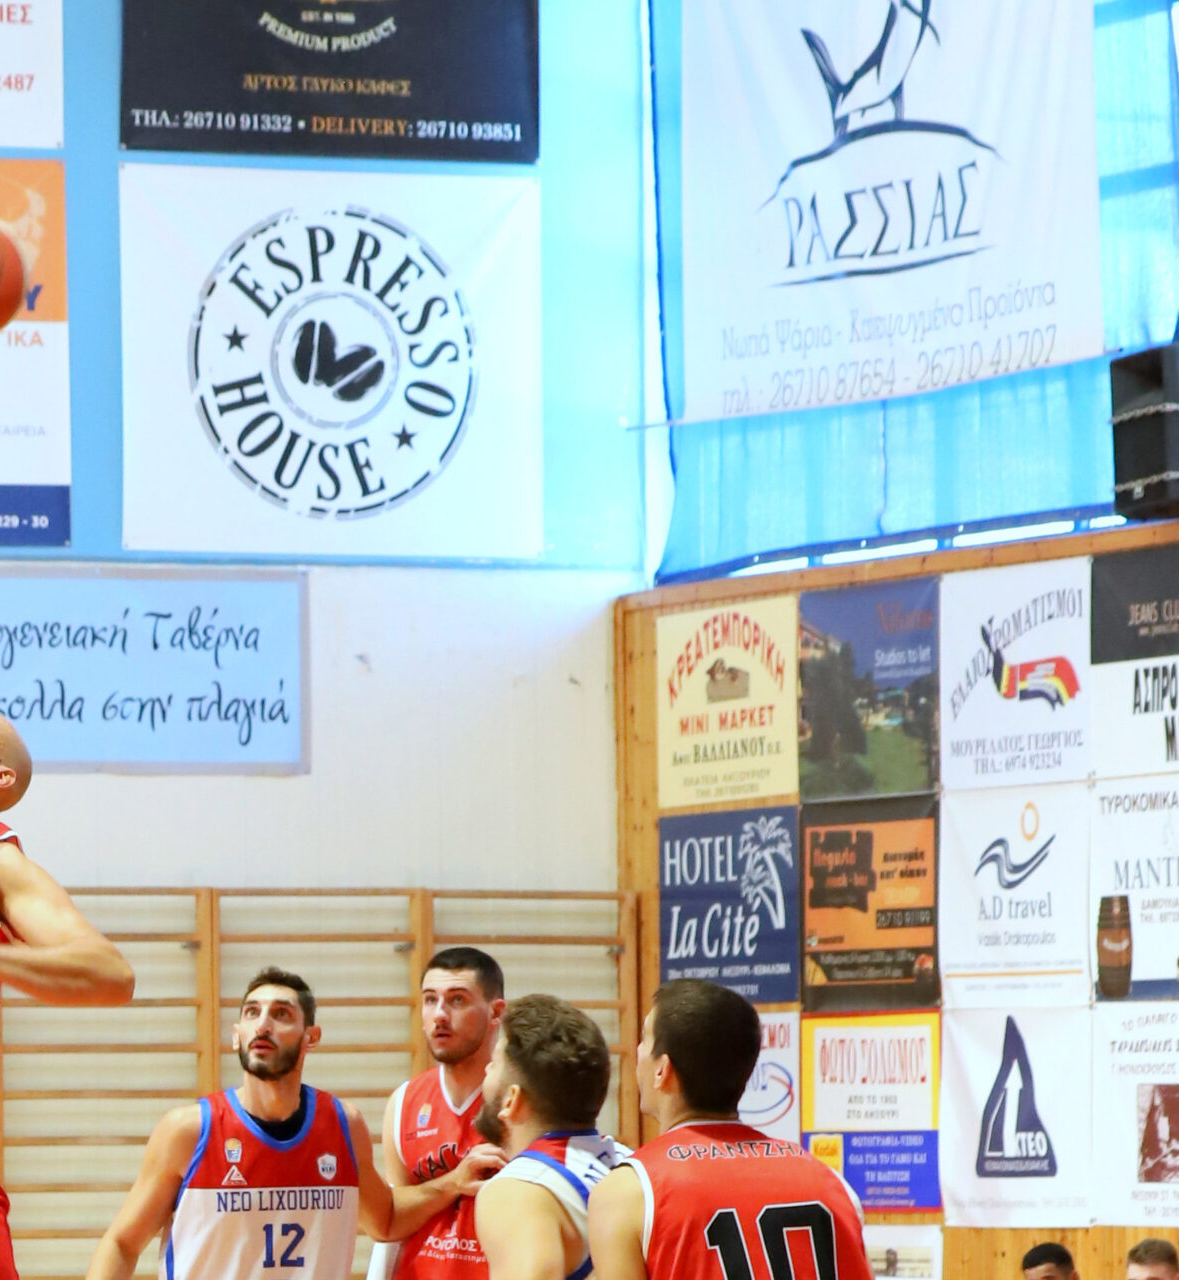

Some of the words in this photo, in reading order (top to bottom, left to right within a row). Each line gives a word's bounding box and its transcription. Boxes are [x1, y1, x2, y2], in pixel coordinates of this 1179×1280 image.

[258, 11, 329, 52] PREMIUM
[331, 16, 398, 53] PRODUCT
[183, 112, 236, 131] 26710
[239, 113, 293, 132] 91332
[312, 116, 414, 137] DELIVERY:
[416, 121, 469, 140] 26710
[471, 123, 522, 142] 93851
[783, 160, 982, 269] ΡΑΣΣΙΑΣ
[228, 225, 460, 419] ESPRESSO
[768, 366, 830, 410] 26710
[835, 356, 897, 402] 87654
[917, 341, 983, 392] 26710
[212, 372, 387, 501] HOUSE
[31, 516, 50, 529] 30
[144, 605, 260, 669] Ταβέρνα
[667, 611, 786, 709] ΚΡΕΑΤΕΜΠΟΡΙΚΗ
[186, 679, 290, 746] πλαγιά
[663, 835, 738, 887] HOTEL
[667, 905, 699, 960] La
[702, 896, 761, 959] Cité
[978, 894, 1004, 921] A.D
[1008, 891, 1053, 919] travel
[819, 1037, 858, 1084] ΦΩΤΟ
[861, 1036, 928, 1085] ΣΟΛΩΜΟΣ
[216, 1191, 252, 1213] NEO
[258, 1188, 345, 1212] LIXOURIOU
[262, 1223, 306, 1269] 12
